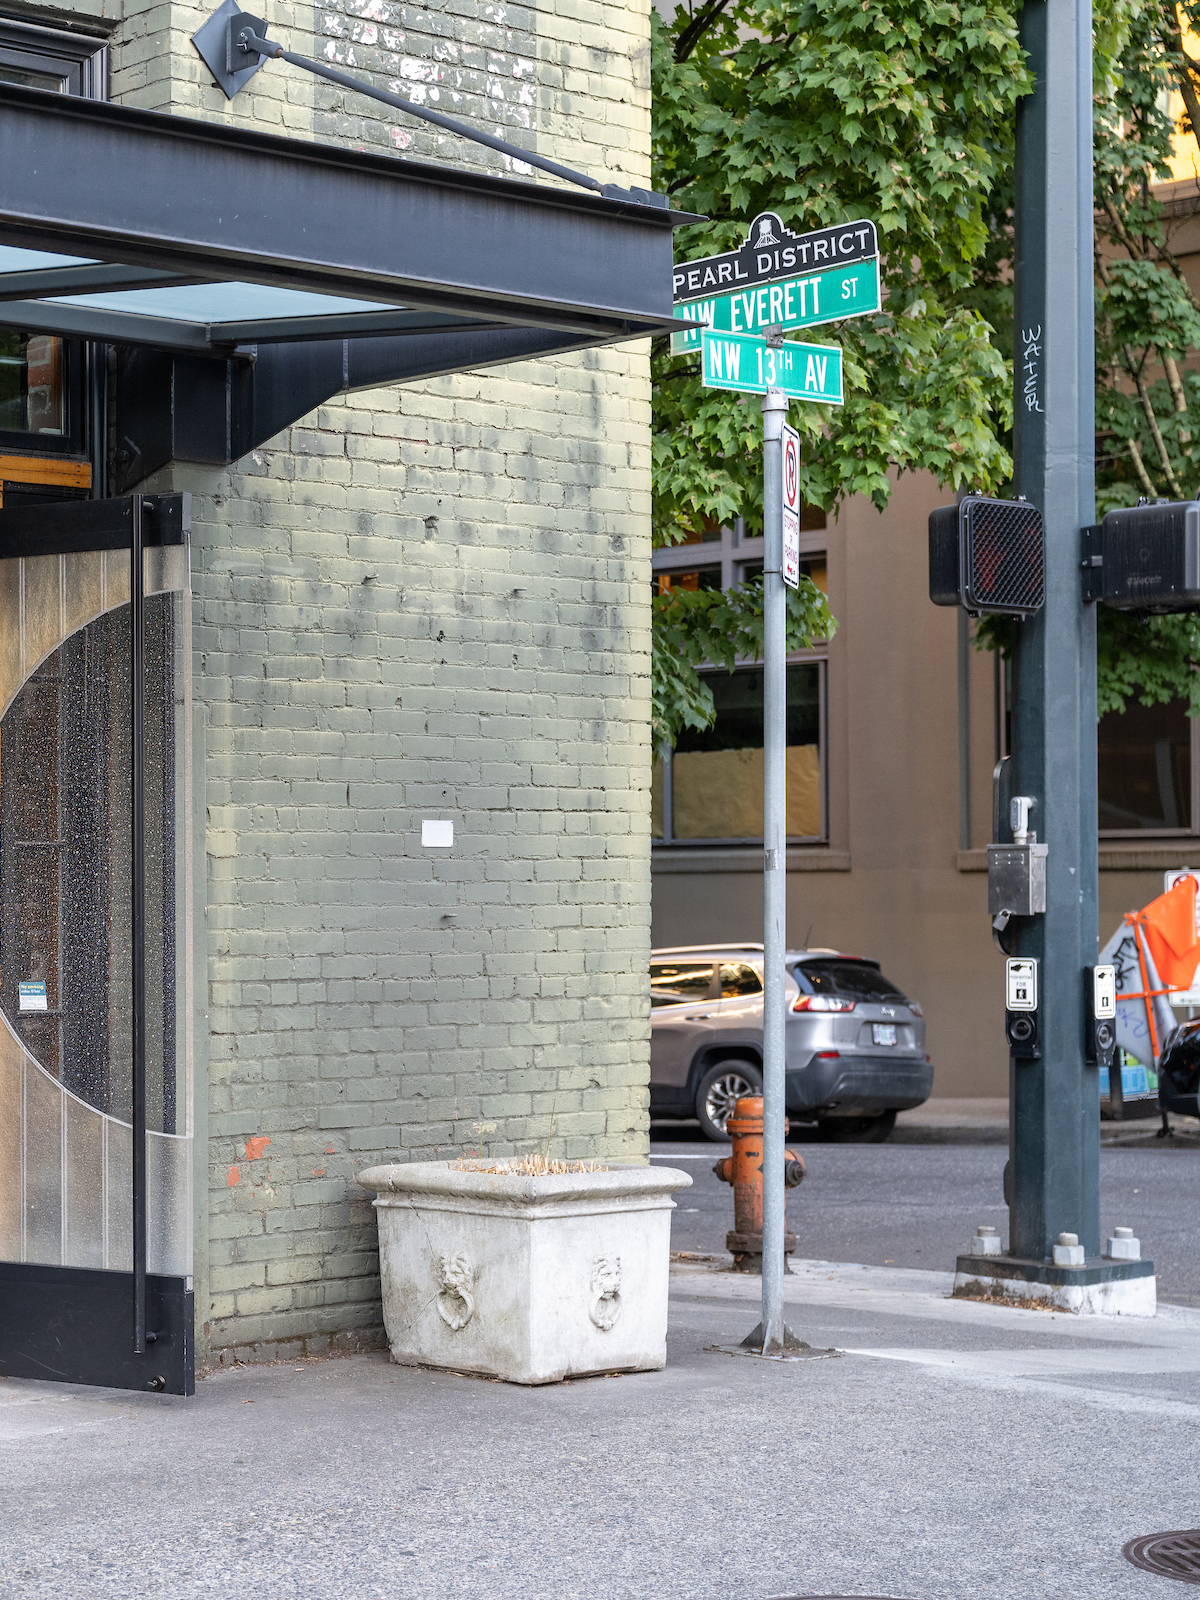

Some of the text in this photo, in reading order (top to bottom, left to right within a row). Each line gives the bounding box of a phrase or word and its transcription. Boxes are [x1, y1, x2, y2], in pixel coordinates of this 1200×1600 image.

[673, 228, 870, 294] PEARL DISTRICT
[683, 276, 859, 342] NW EVERETT ST
[709, 339, 741, 381] NW
[804, 354, 827, 393] AV
